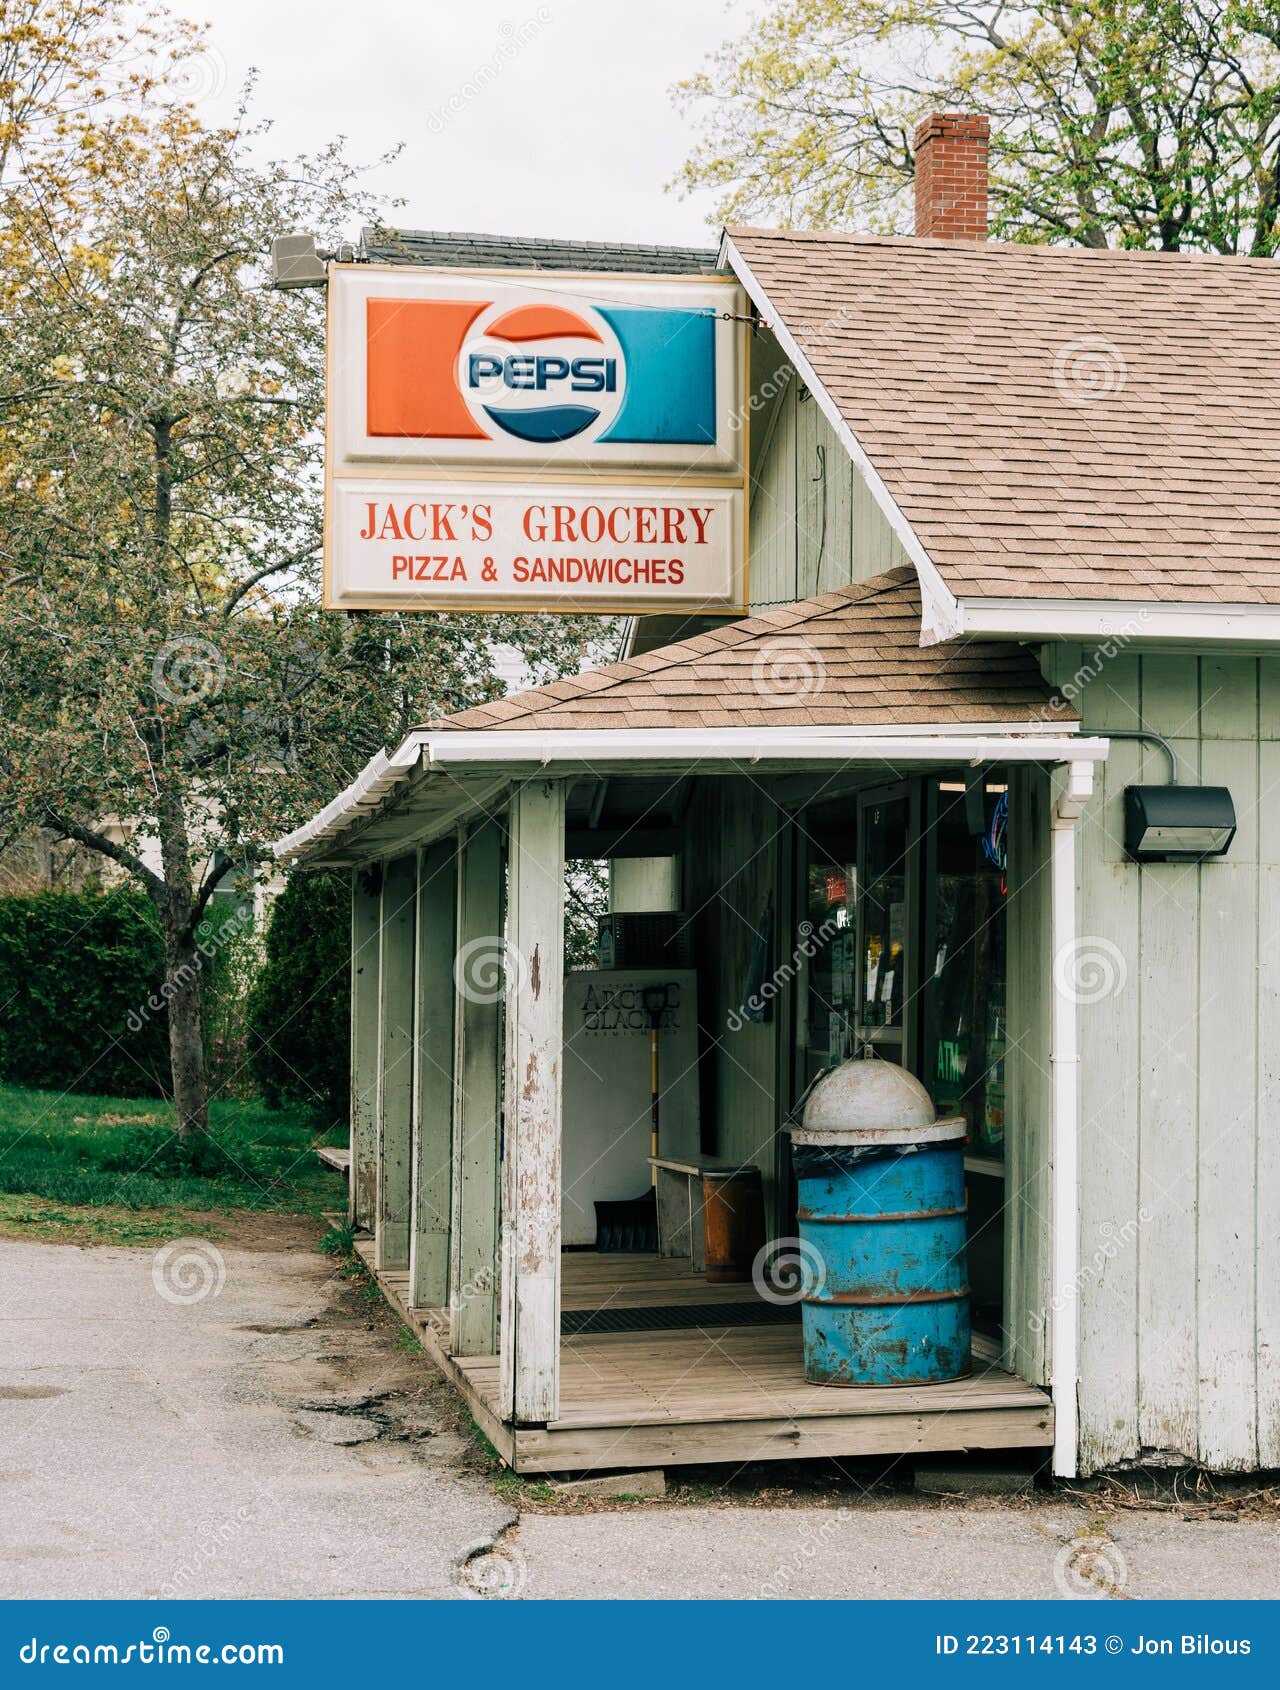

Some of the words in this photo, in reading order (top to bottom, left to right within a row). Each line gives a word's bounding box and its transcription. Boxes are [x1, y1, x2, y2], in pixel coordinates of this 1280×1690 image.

[468, 353, 617, 393] PEPSI
[360, 502, 493, 541] JACK'S
[522, 505, 715, 545] GROCERY
[391, 555, 468, 582] PIZZA
[480, 556, 498, 583] &
[513, 557, 685, 585] SANDWICHES
[937, 1040, 960, 1082] ATM
